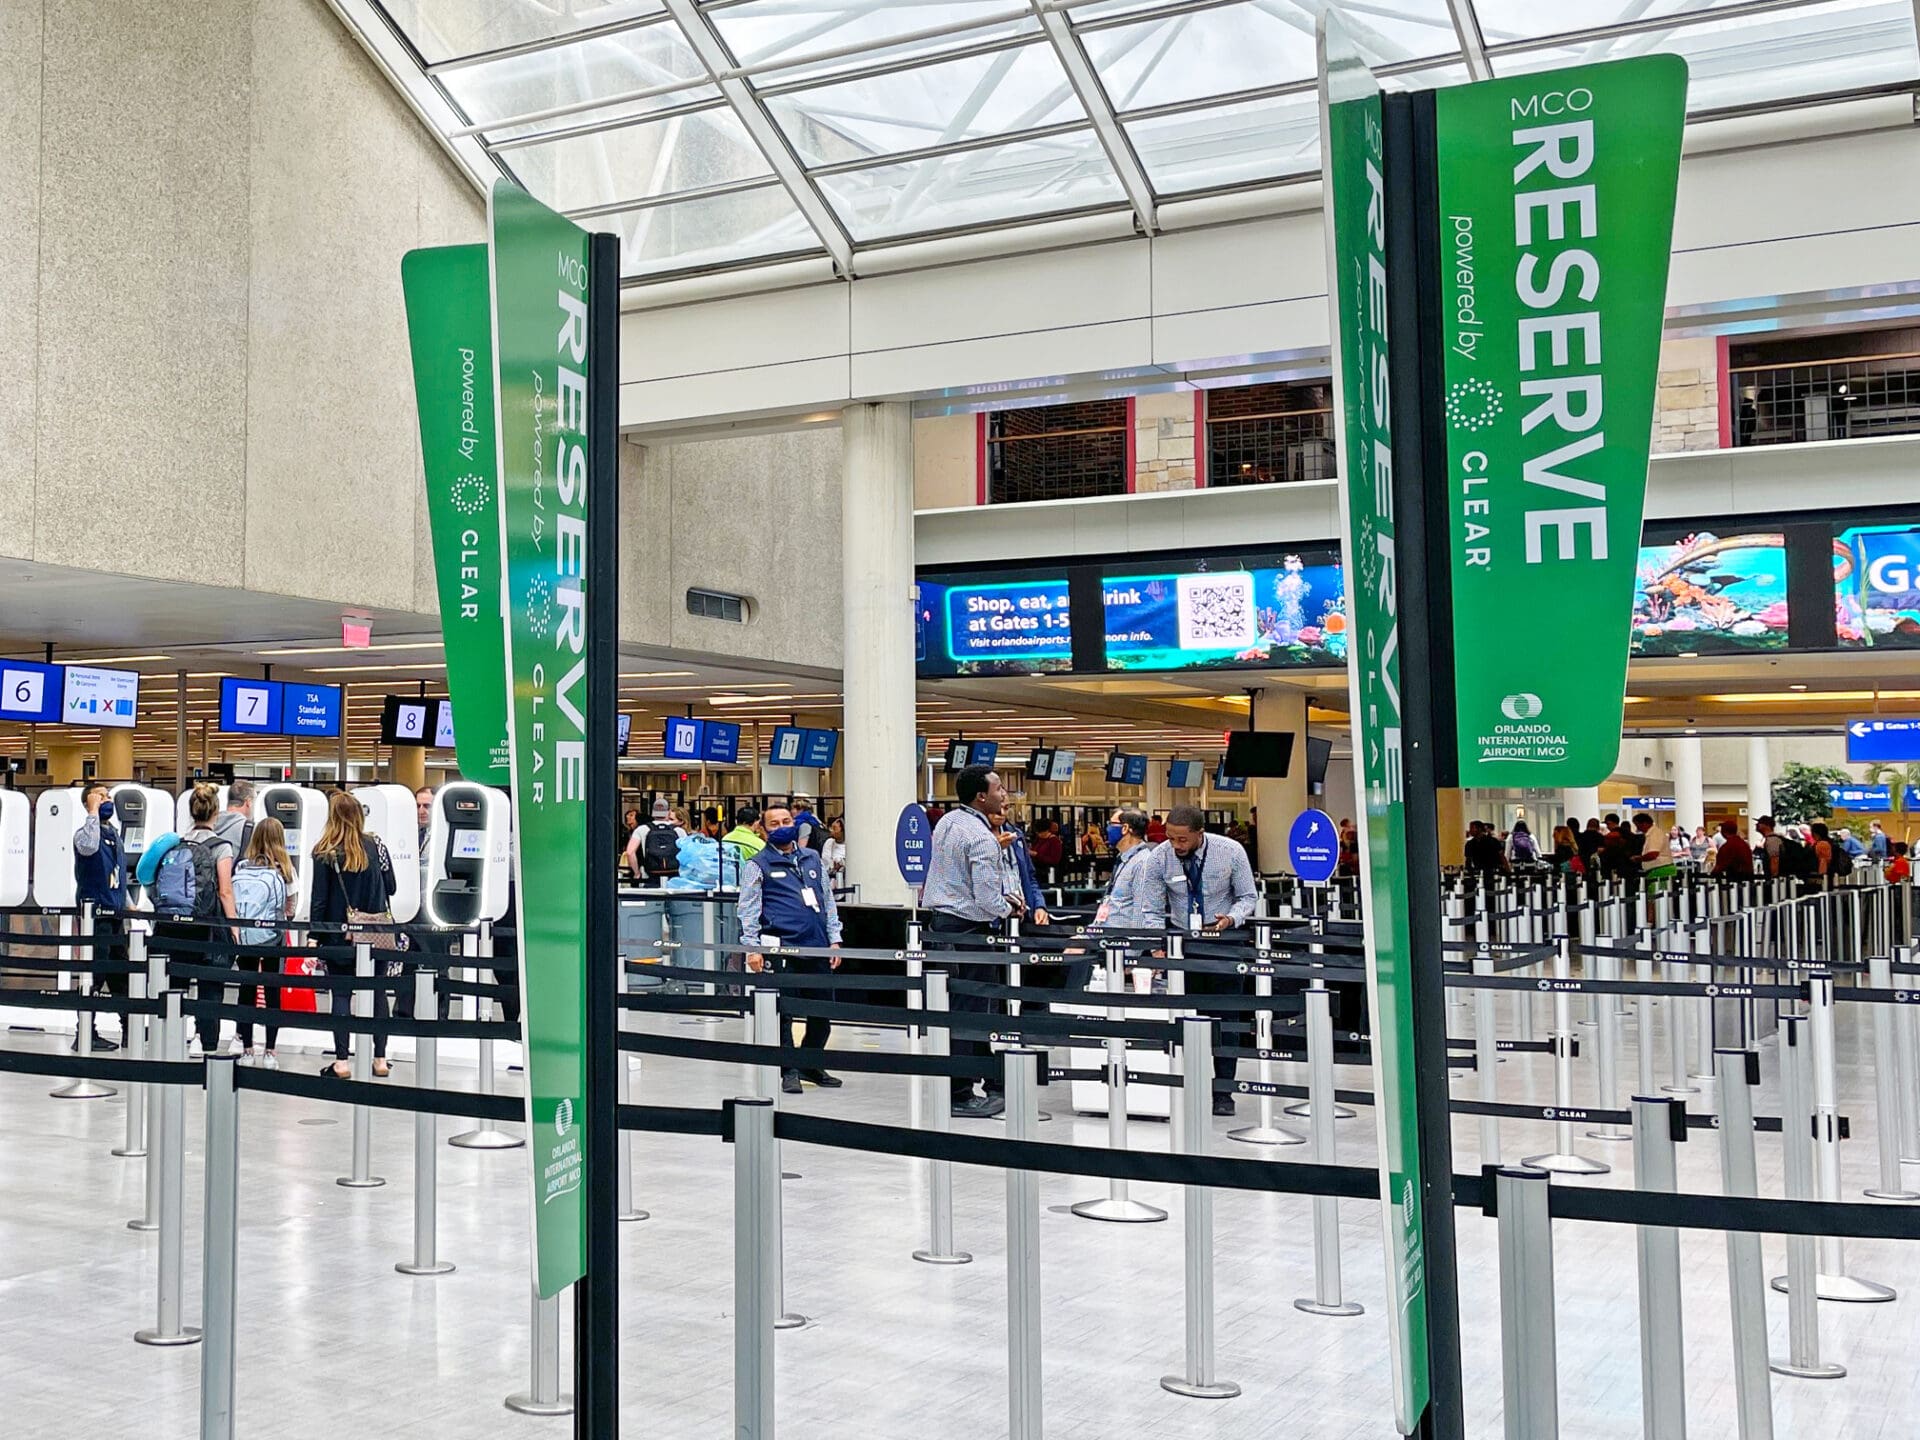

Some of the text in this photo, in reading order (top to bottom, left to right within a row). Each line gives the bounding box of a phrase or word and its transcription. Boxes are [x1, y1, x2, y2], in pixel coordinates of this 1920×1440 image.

[1511, 88, 1593, 120] MCO
[1365, 108, 1383, 160] MCO
[558, 250, 588, 291] MCO
[1448, 215, 1483, 360] powered by
[1512, 119, 1608, 564] RESERVE
[458, 348, 479, 461] powered by
[531, 370, 545, 553] powered by
[1366, 158, 1404, 805] RESERVE
[1462, 450, 1491, 567] CLEAR
[556, 289, 588, 803] RESERVE
[460, 529, 479, 618] CLEAR
[967, 597, 1015, 613] Shop,
[1019, 596, 1052, 610] eat,
[1103, 588, 1142, 606] rink
[968, 613, 1070, 632] at Gates 1-5
[969, 638, 991, 648] Visit
[1129, 631, 1153, 642] info.
[15, 680, 31, 702] 6
[307, 693, 319, 703] TSA
[247, 697, 259, 717] 7
[298, 705, 326, 715] Standard
[1367, 628, 1380, 805] CLEAR
[297, 716, 327, 728] Screening
[405, 712, 416, 731] 8
[1494, 724, 1551, 734] ORLANDO
[532, 662, 545, 804] CLEAR
[677, 730, 693, 747] 10
[1478, 735, 1568, 745] INTERNATIONAL
[783, 739, 795, 754] 11
[955, 750, 966, 764] 13
[1483, 747, 1565, 756] AIRPORT MCO
[904, 840, 924, 848] CLEAR
[1252, 1085, 1277, 1093] CLEAR
[1558, 1110, 1587, 1118] CLEAR
[551, 1138, 576, 1160] ORLANDO
[544, 1151, 583, 1179] INTERNATIONAL
